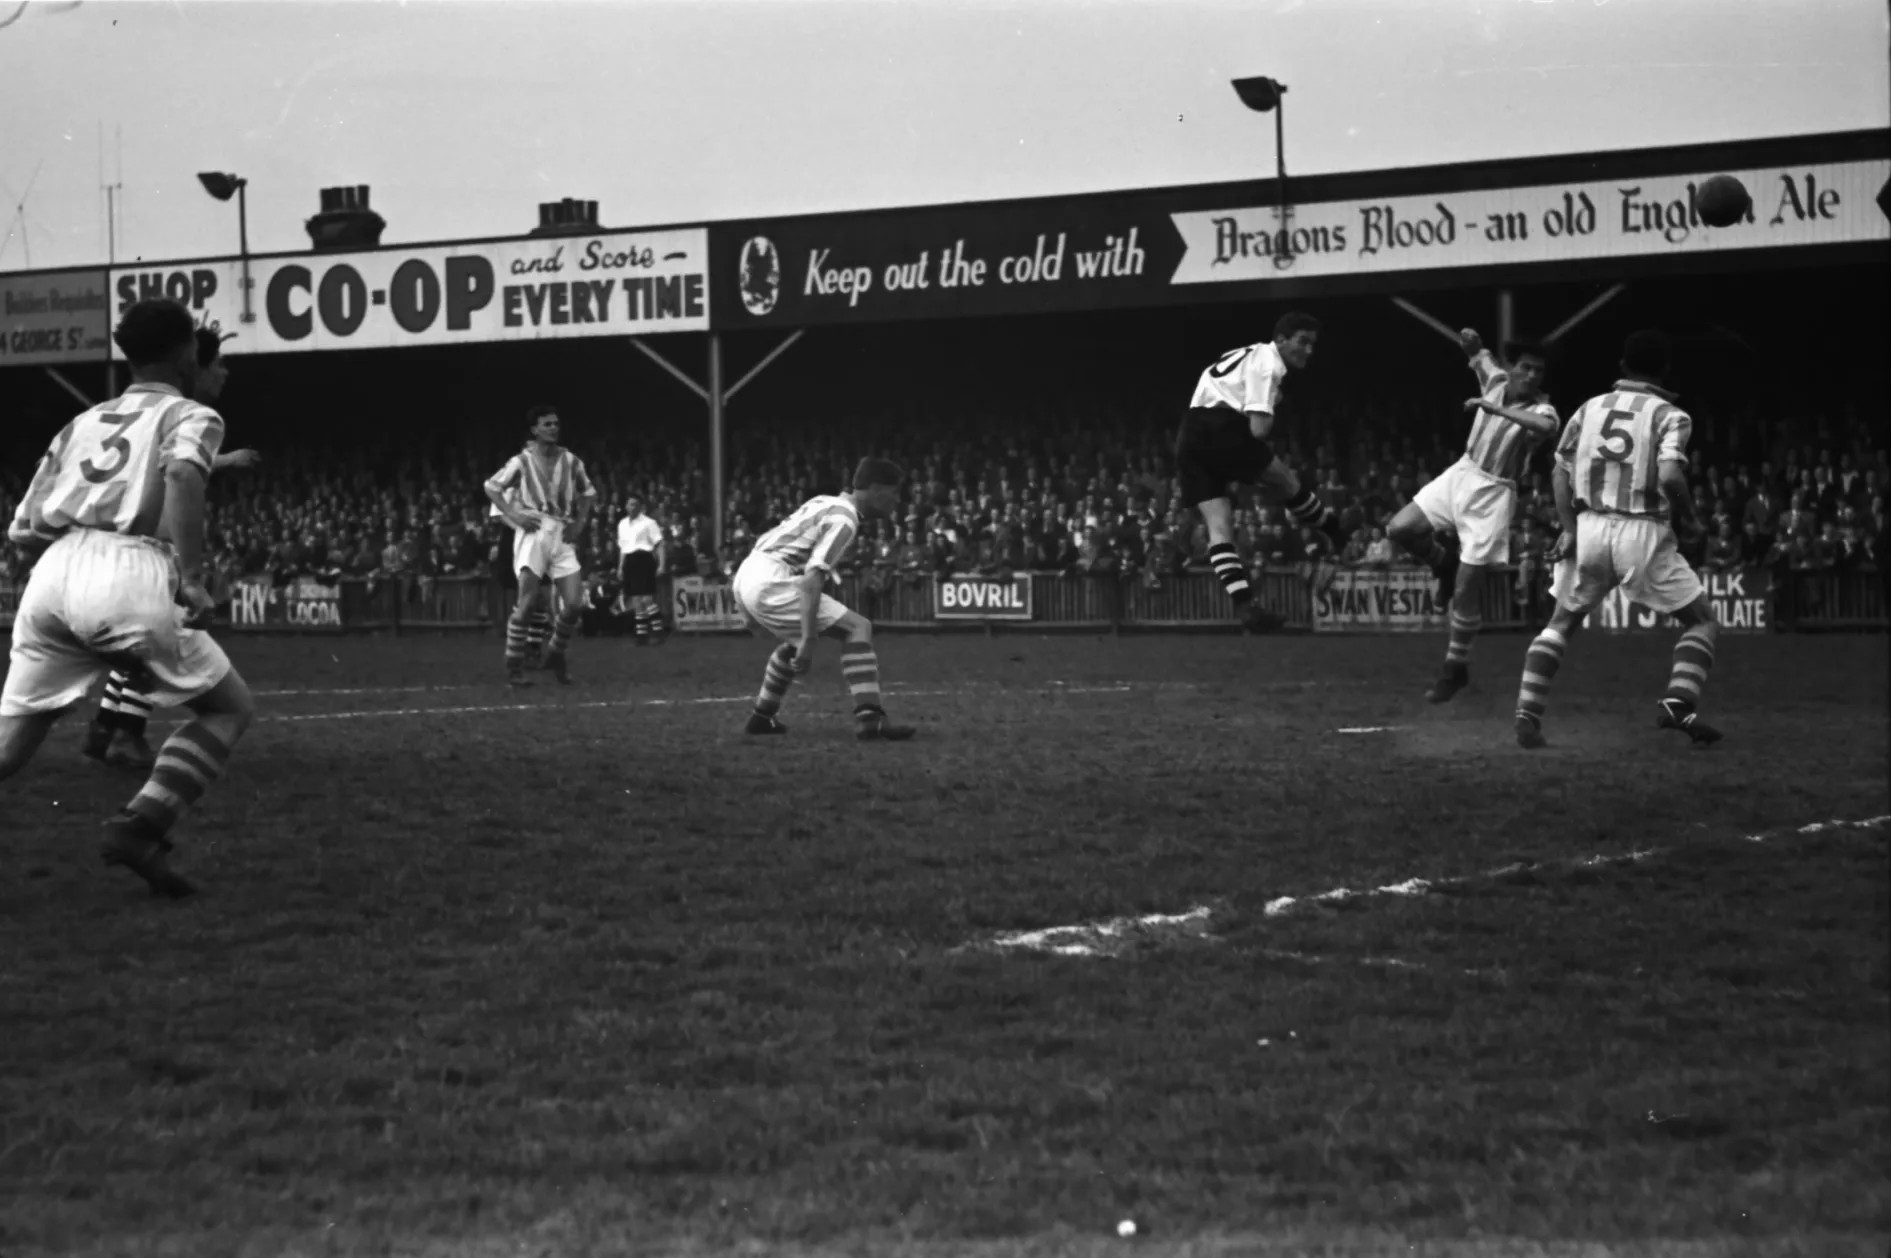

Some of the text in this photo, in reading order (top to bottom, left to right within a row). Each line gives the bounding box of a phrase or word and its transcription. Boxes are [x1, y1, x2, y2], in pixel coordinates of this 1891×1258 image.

[1211, 216, 1347, 271] Dragons
[1358, 202, 1457, 256] Blood
[1484, 212, 1528, 243] an
[1543, 191, 1597, 238] old
[1619, 183, 1756, 242] Engl
[1769, 173, 1841, 228] Ale
[510, 245, 565, 275] and
[579, 240, 656, 272] Score
[804, 227, 1146, 308] Keep out the cold with
[117, 268, 218, 314] SHOP
[266, 254, 496, 342] CO-OP
[503, 274, 705, 328] EVERY TIME
[79, 410, 145, 484] 3
[1596, 409, 1636, 463] 5
[286, 602, 341, 626] COCOA
[676, 588, 718, 619] SWAN
[942, 581, 1024, 608] BOVRIL
[1316, 587, 1370, 617] SWAN
